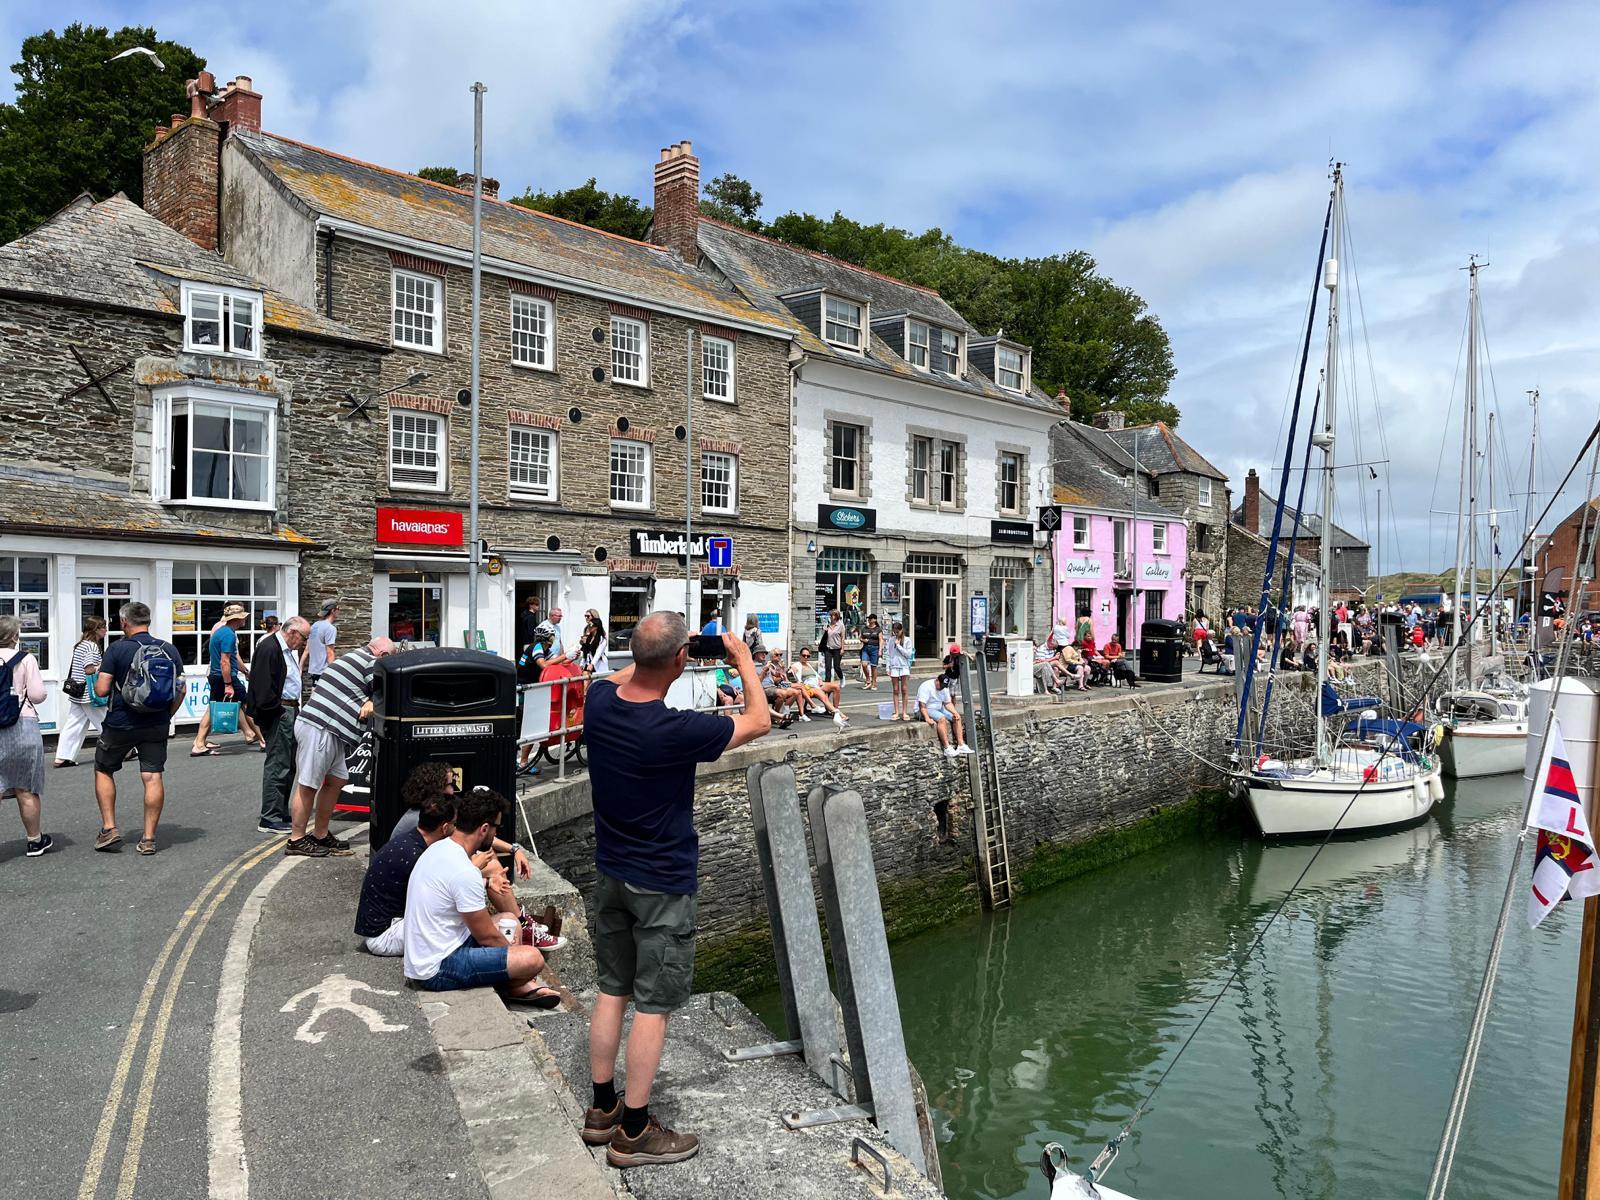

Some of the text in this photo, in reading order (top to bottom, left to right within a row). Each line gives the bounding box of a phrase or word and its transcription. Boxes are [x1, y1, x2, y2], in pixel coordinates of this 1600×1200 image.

[391, 518, 449, 535] havaianas
[636, 532, 705, 556] Timberland
[1067, 562, 1100, 574] Quay Art
[1145, 566, 1169, 578] Gallery
[448, 725, 465, 734] DOG
[466, 725, 490, 733] WASTE
